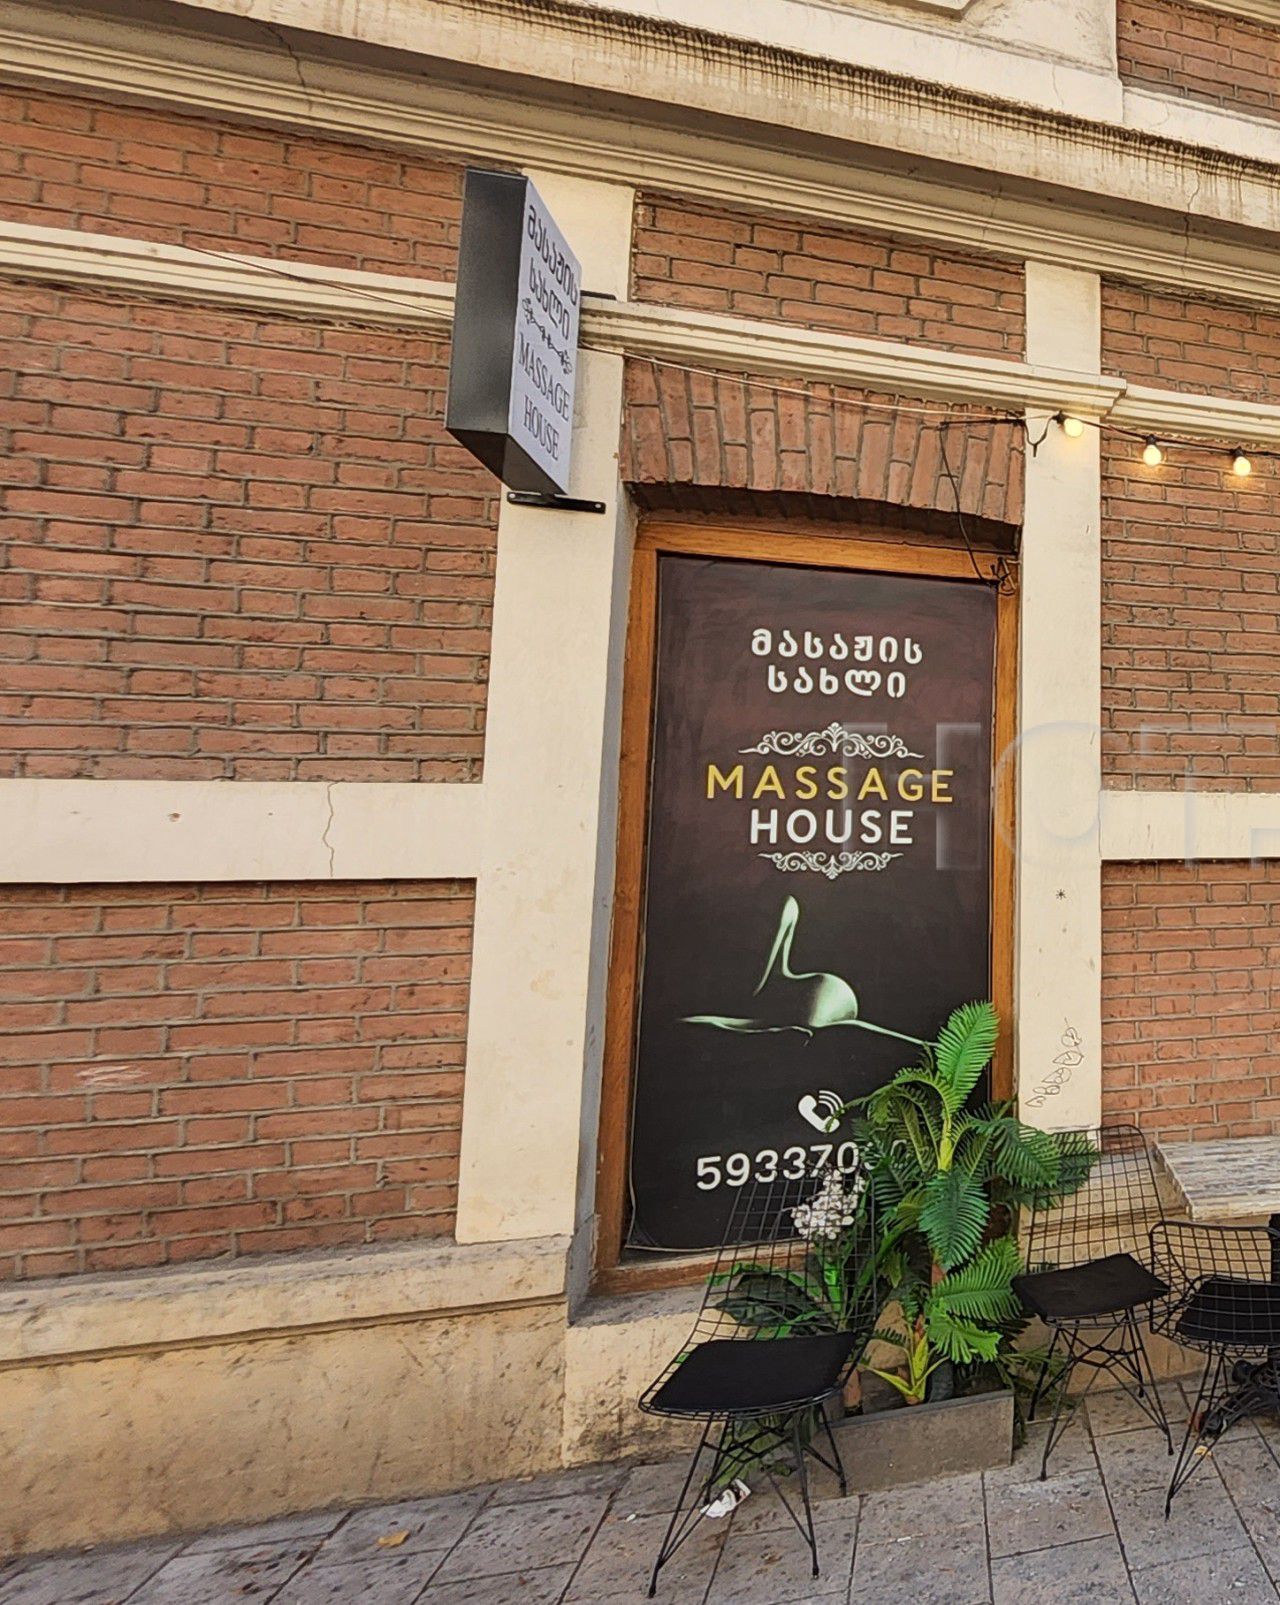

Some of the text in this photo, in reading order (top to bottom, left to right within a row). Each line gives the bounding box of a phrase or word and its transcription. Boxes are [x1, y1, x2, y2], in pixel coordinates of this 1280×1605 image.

[527, 204, 578, 306] მასაჟის
[529, 256, 570, 341] სახლი
[518, 331, 570, 423] MASSAGE
[523, 394, 560, 462] HOUSE
[750, 627, 923, 665] მასაჟის
[767, 664, 907, 699] სახლი
[706, 763, 954, 804] MASSAGE
[749, 807, 914, 846] HOUSE
